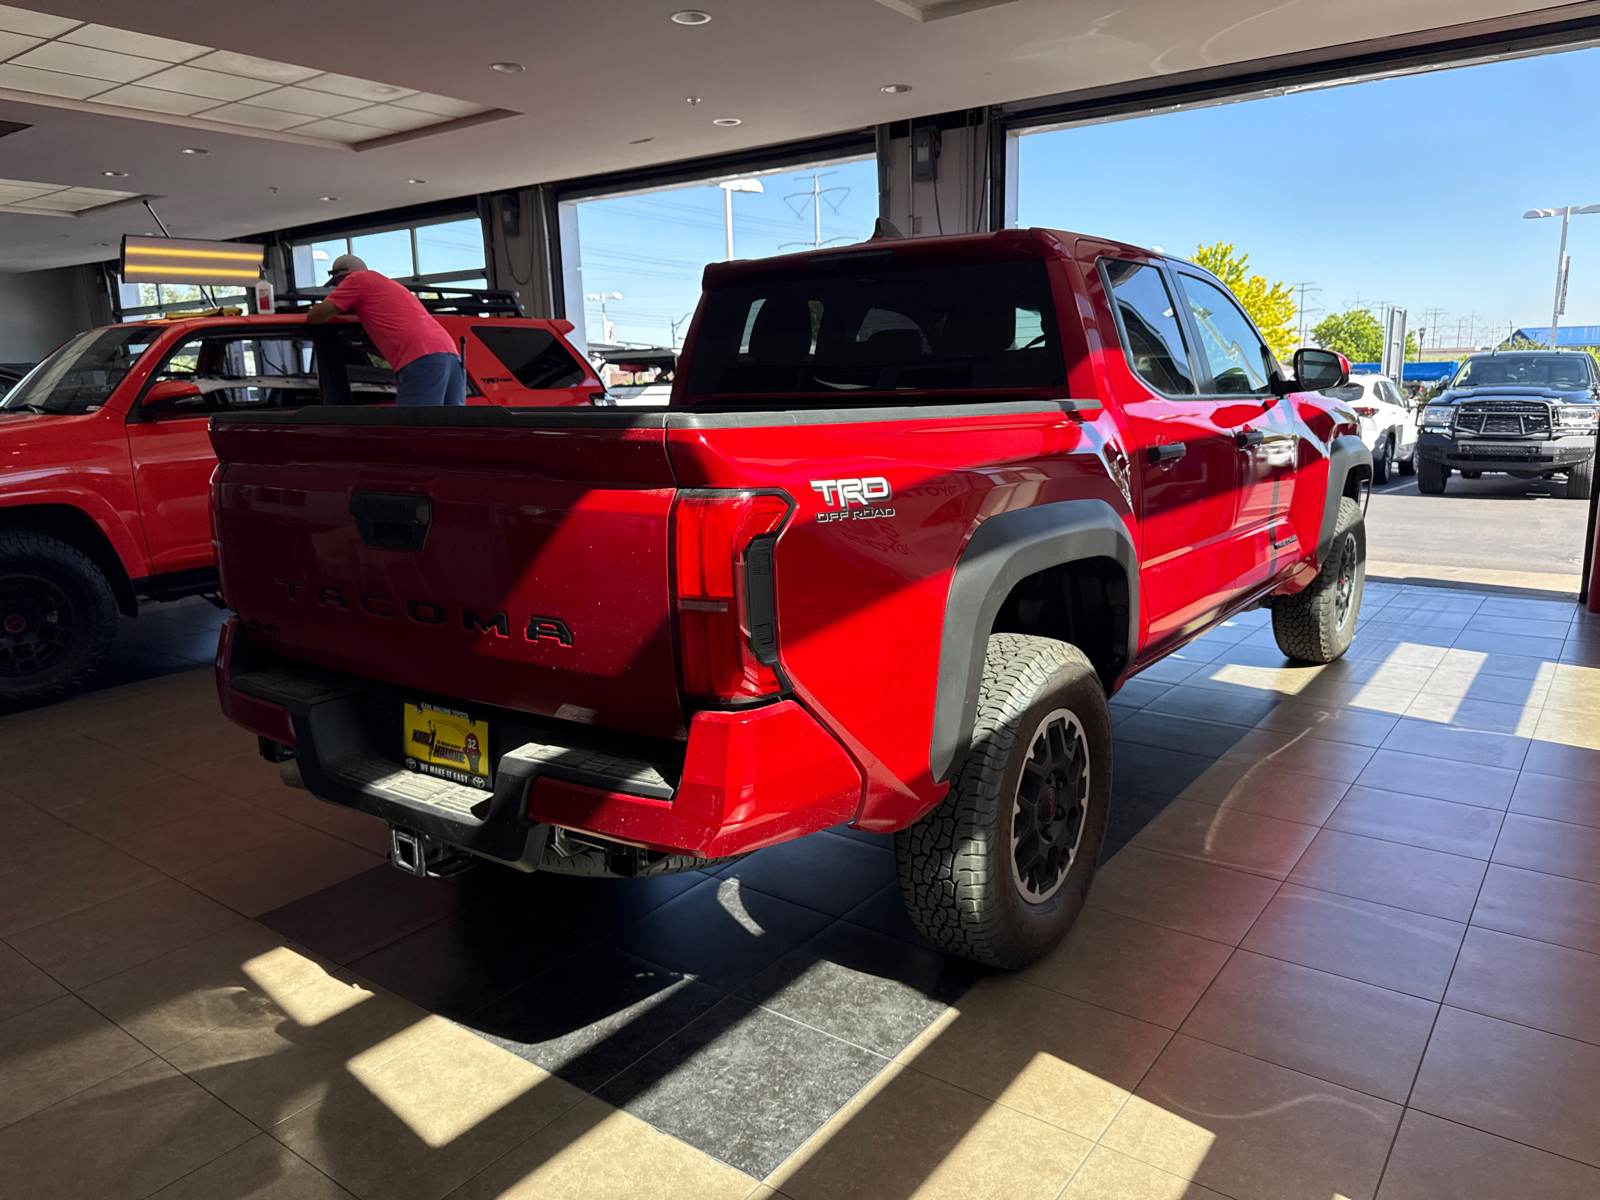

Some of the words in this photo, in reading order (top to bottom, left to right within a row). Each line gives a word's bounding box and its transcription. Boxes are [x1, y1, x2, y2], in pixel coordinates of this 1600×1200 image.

[809, 476, 892, 510] TRD
[815, 511, 850, 523] OFF
[851, 507, 896, 521] ROAD
[274, 576, 573, 648] TACOMA
[411, 729, 431, 746] KARL
[467, 738, 477, 750] 32
[432, 744, 466, 764] MALONE
[420, 763, 429, 772] WE
[429, 765, 445, 777] MAKE
[446, 771, 452, 779] IT
[453, 773, 468, 784] EASY
